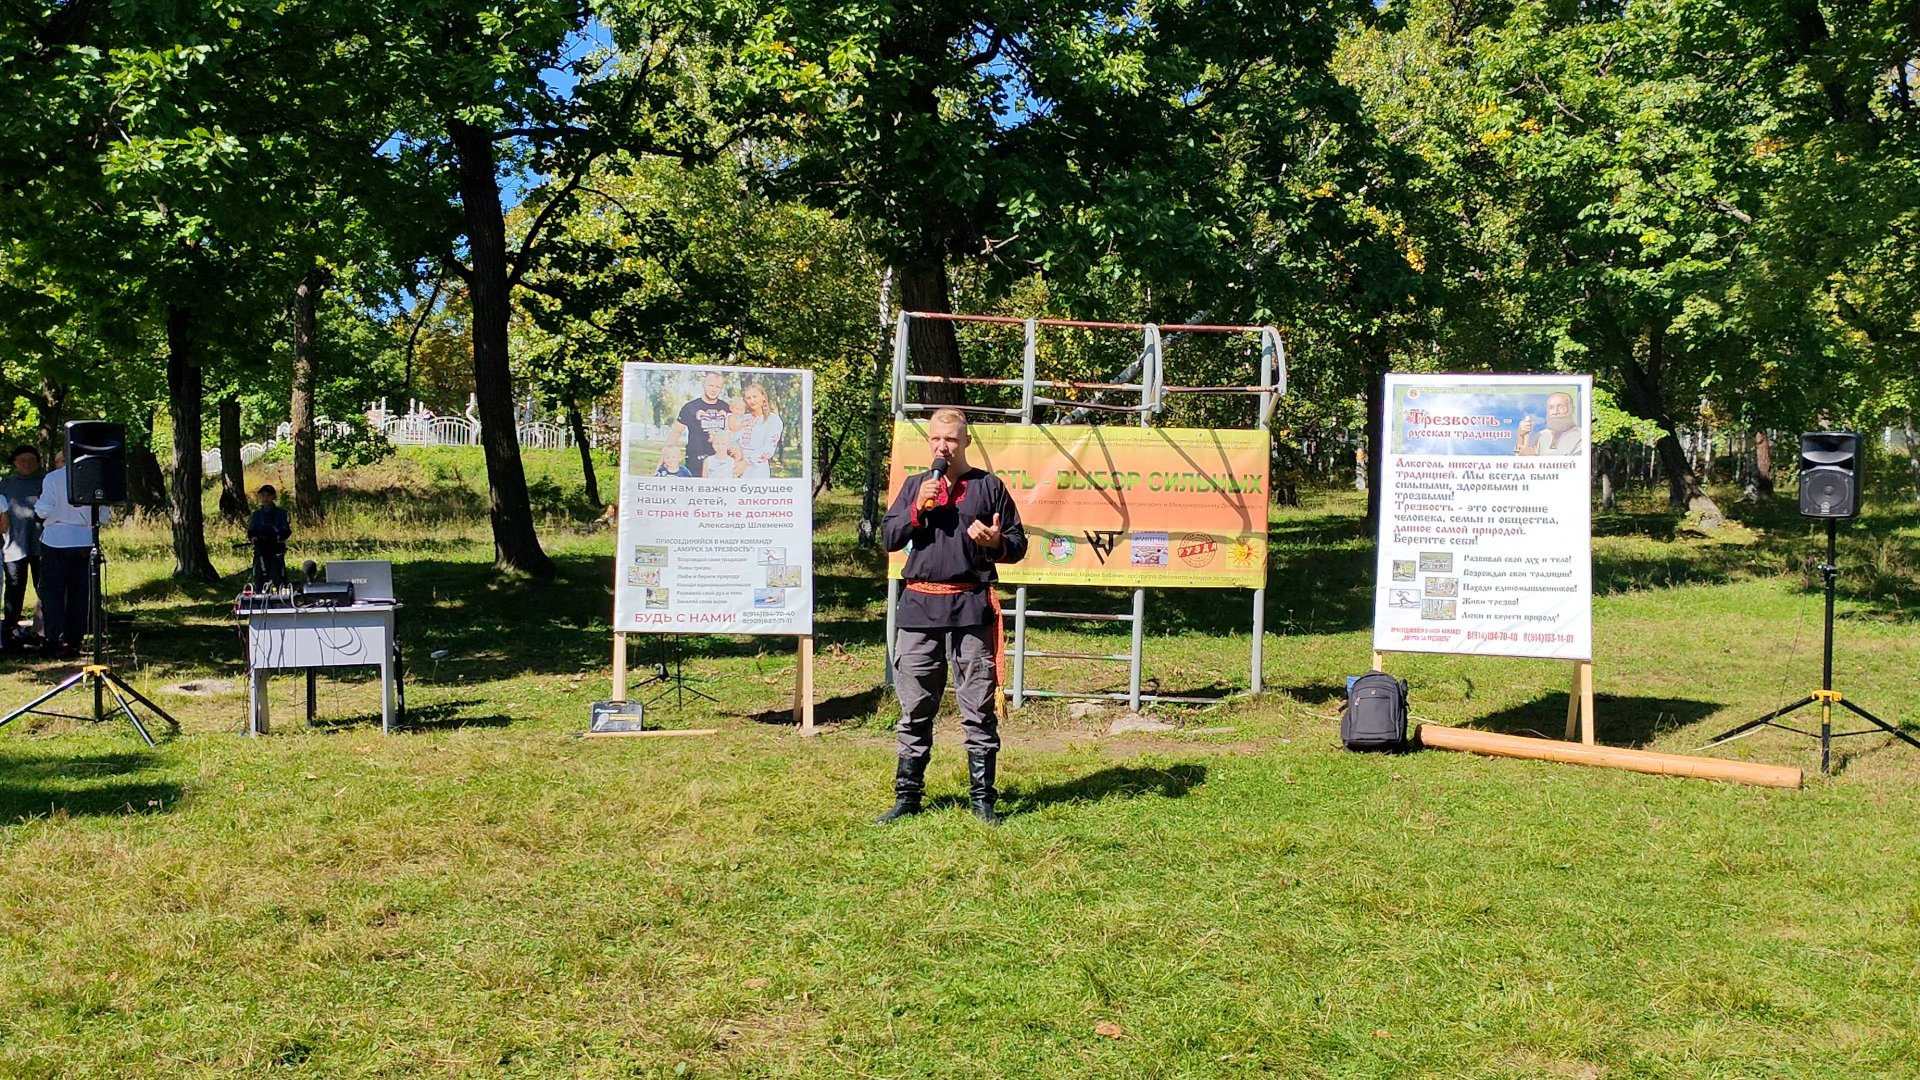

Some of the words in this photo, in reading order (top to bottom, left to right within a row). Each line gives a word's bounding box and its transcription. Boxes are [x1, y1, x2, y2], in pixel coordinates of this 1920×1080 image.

[1407, 409, 1499, 428] Трезвость
[1408, 429, 1451, 440] русская
[1454, 430, 1511, 440] традиция
[1396, 459, 1444, 469] Алкоголь
[1449, 461, 1491, 470] никогда
[1513, 461, 1534, 469] был
[1539, 461, 1576, 469] нашей
[904, 465, 1036, 490] ТРСТЬ
[1057, 470, 1141, 491] ВЫБОР
[1149, 471, 1263, 494] СИЛЬНЫХ
[1396, 471, 1458, 480] традицией.
[1463, 471, 1484, 480] Мы
[1489, 472, 1525, 480] всегда
[637, 483, 666, 492] Если
[741, 485, 793, 495] будущее
[1456, 484, 1518, 492] здоровыми
[689, 496, 726, 506] детей,
[1395, 492, 1454, 501] трезвыми!
[1395, 502, 1453, 512] Трезвость
[648, 510, 688, 519] стране
[694, 509, 723, 518] быть
[746, 511, 793, 519] должно
[1394, 515, 1445, 523] человека,
[1450, 515, 1483, 523] семьи
[1499, 516, 1558, 525] общества,
[699, 522, 746, 530] Александр
[1394, 525, 1431, 533] данное
[1436, 526, 1467, 534] самой
[1472, 527, 1525, 536] природой.
[1394, 535, 1445, 545] Берегите
[1450, 536, 1478, 545] себя!
[1178, 542, 1217, 557] РУЗДА
[1463, 554, 1502, 563] Развивай
[1525, 556, 1539, 565] дух
[1550, 555, 1572, 563] тело!
[1463, 569, 1506, 578] Возрождай
[1530, 570, 1573, 579] традиции!
[1463, 583, 1493, 592] Находи
[1462, 598, 1485, 606] Живи
[1487, 598, 1519, 607] трезво!
[635, 613, 672, 623] БУДЬ
[677, 613, 685, 622] С
[690, 613, 736, 623] НАМИ!
